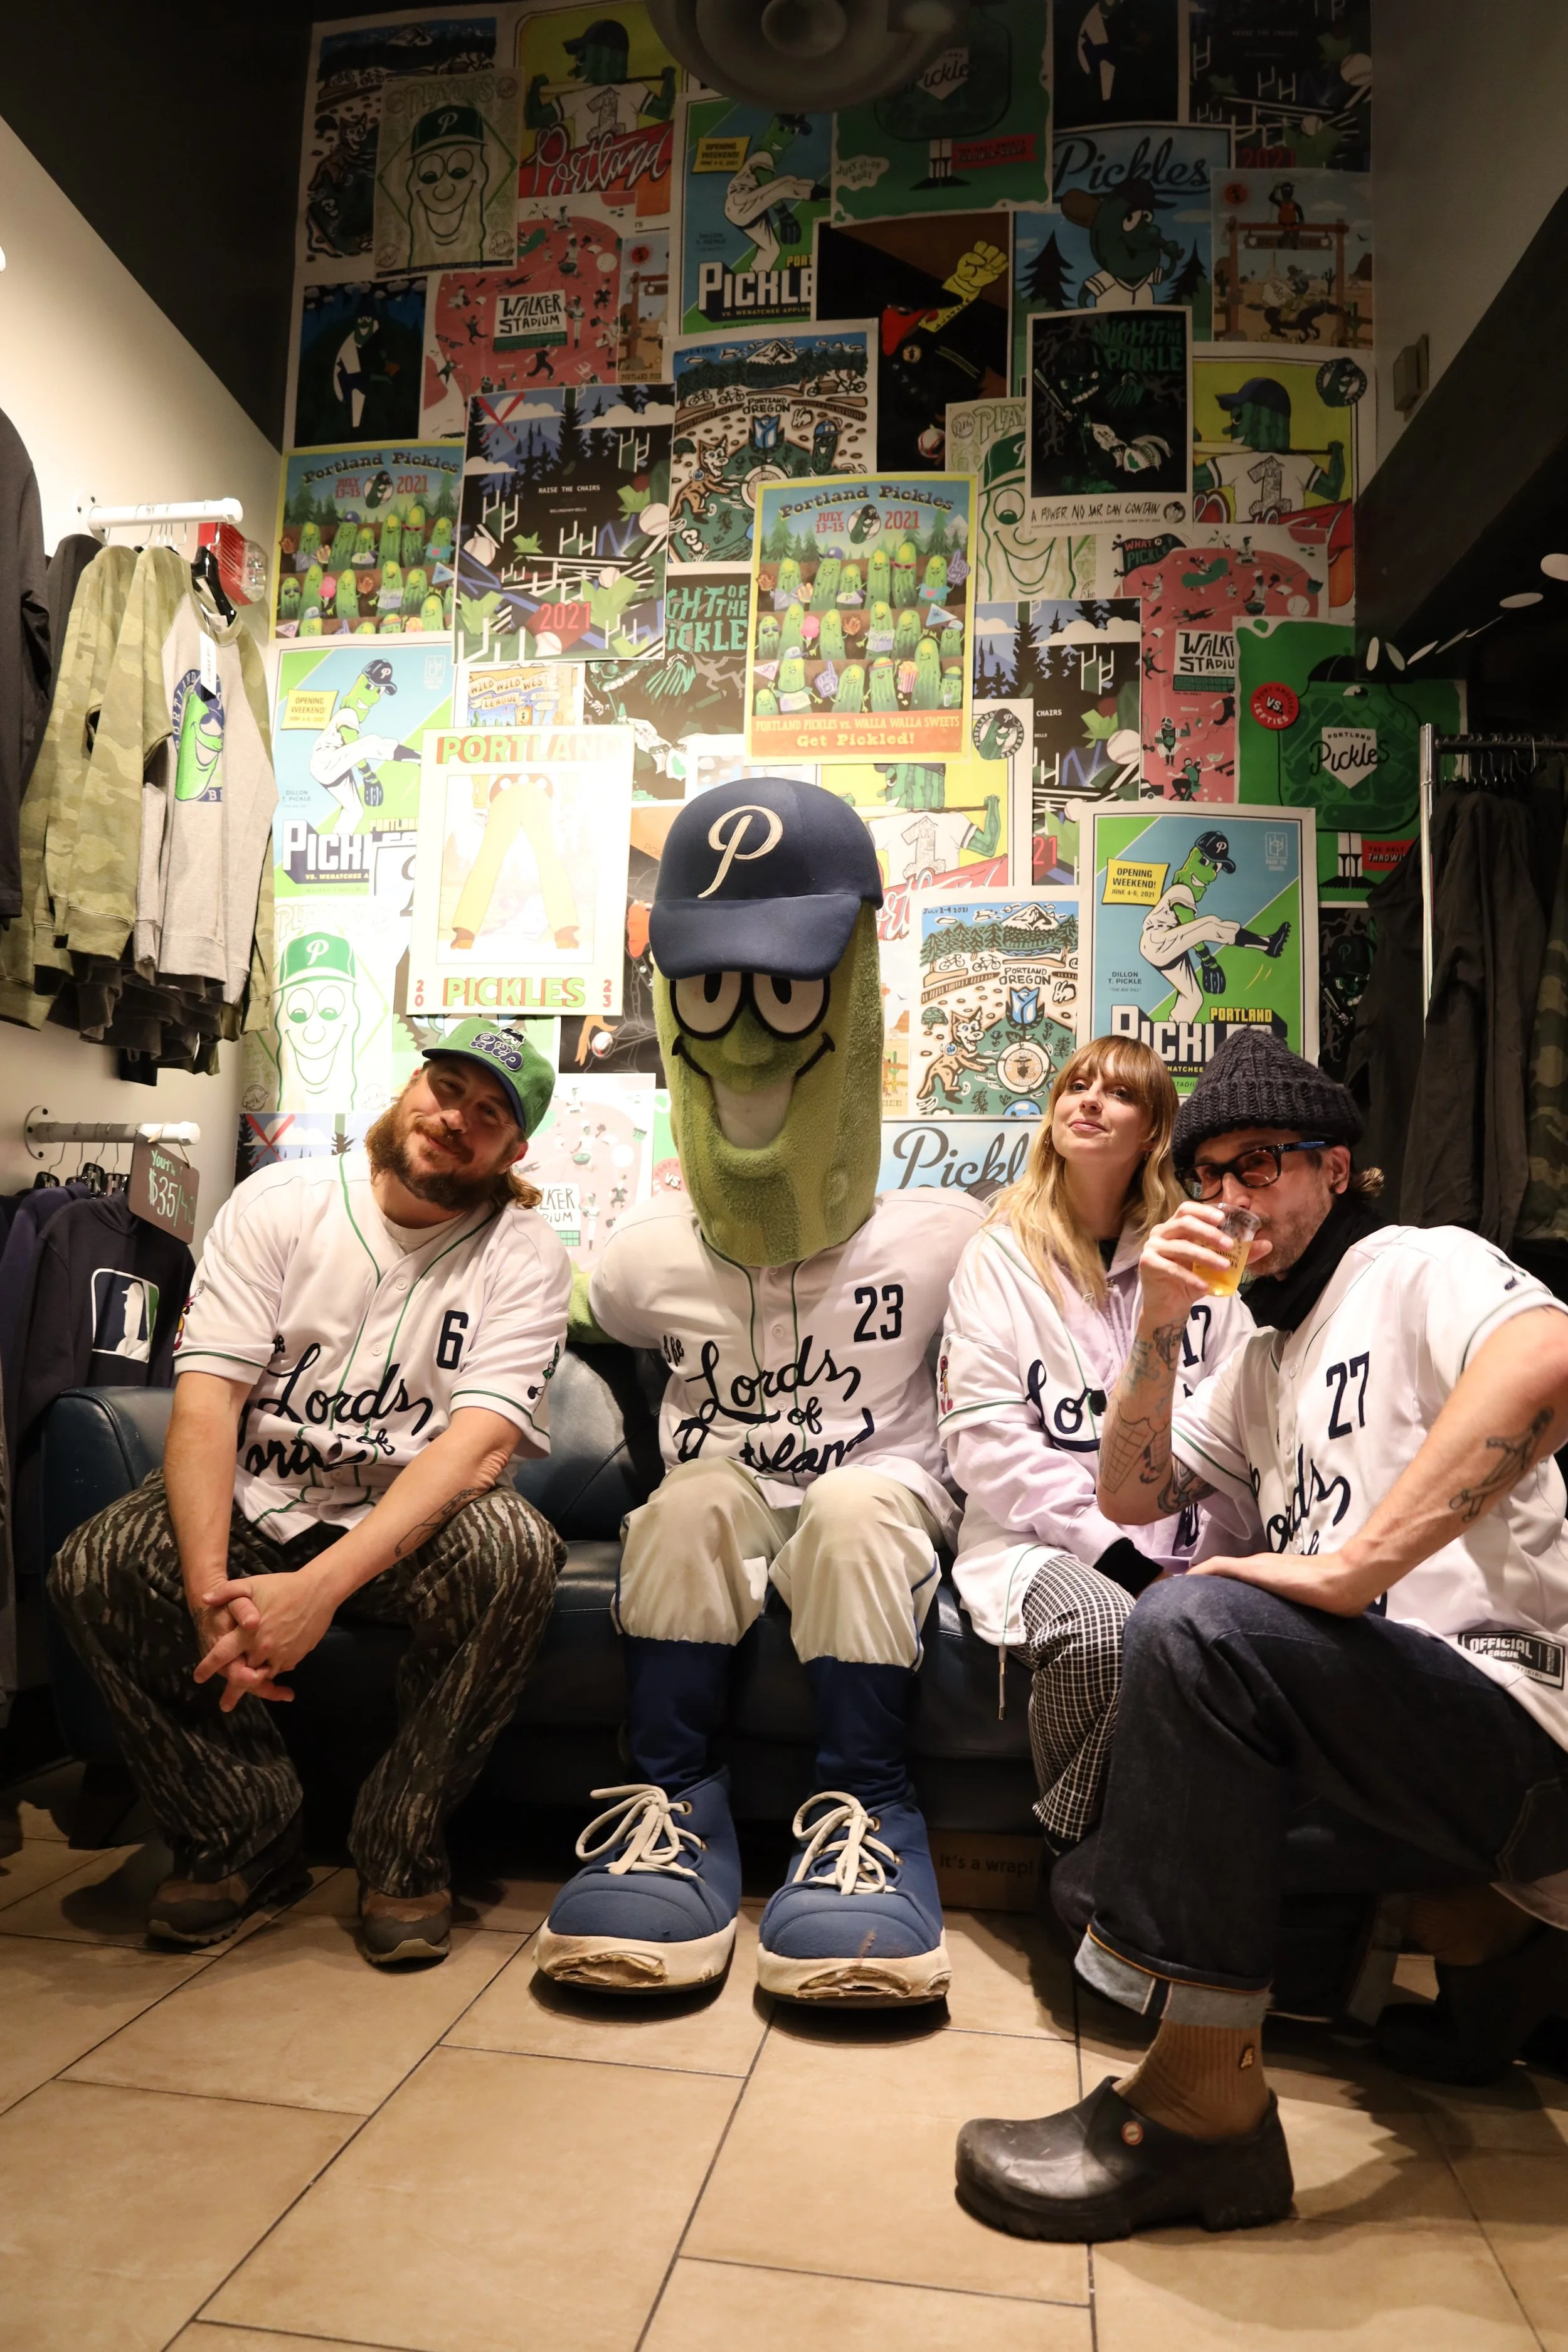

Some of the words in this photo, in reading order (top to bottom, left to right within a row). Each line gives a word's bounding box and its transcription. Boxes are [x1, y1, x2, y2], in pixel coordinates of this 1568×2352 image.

[527, 125, 672, 196] Portland
[1054, 135, 1207, 194] Pickles
[499, 293, 563, 317] WALKER
[736, 308, 780, 316] WENATCHEE
[499, 314, 560, 334] STADIUM
[742, 403, 790, 415] OREGON
[748, 397, 787, 405] PORTLAND
[303, 453, 384, 484] Portland
[392, 452, 460, 479] Pickles
[336, 477, 360, 489] JULY
[396, 475, 428, 494] 2021
[779, 485, 870, 520] Portland
[879, 485, 954, 511] Pickles
[1030, 510, 1037, 522] A
[1041, 506, 1068, 521] POWER
[1071, 505, 1084, 520] NO
[1088, 503, 1103, 517] JAR
[1106, 503, 1121, 516] CAN
[1125, 502, 1161, 515] CONTAIN
[817, 511, 844, 522] JULY
[884, 510, 920, 530] 2021
[815, 521, 844, 534] 13-15
[728, 584, 749, 599] OF
[539, 601, 591, 630] 2021
[715, 598, 748, 617] THE
[380, 667, 391, 679] P
[1254, 702, 1290, 725] LEFTIES
[1266, 696, 1283, 714] VS.
[755, 719, 802, 732] PORTLAND
[803, 719, 838, 731] PICKLES
[855, 718, 887, 729] WALLA
[890, 717, 923, 729] WALLA
[924, 716, 960, 728] SWEETS
[973, 712, 994, 746] PORTLAND
[796, 734, 827, 748] Get
[836, 733, 916, 748] Pickled!
[1327, 731, 1372, 741] PORTLAND
[436, 734, 623, 765] PORTLAND
[1309, 740, 1391, 776] Pickles
[698, 805, 783, 899] P
[1216, 841, 1227, 854] P
[1117, 867, 1153, 878] OPENING
[1113, 877, 1157, 889] WEEKEND!
[1127, 889, 1138, 898] 4-6,
[306, 939, 330, 966] P
[999, 975, 1051, 985] OREGON
[1005, 967, 1047, 976] PORTLAND
[442, 977, 586, 1008] PICKLES
[1210, 1007, 1273, 1023] PORTLAND
[893, 1126, 1029, 1190] Pickl
[854, 1284, 904, 1343] 23
[436, 1310, 469, 1370] 6
[258, 1342, 433, 1436] Lords
[684, 1335, 861, 1425] Lords
[1325, 1351, 1370, 1440] 27
[787, 1396, 823, 1435] of
[1469, 1637, 1533, 1660] OFFICIAL
[1483, 1649, 1520, 1660] LEAGUE
[970, 1858, 980, 1872] a
[985, 1860, 1034, 1878] wrap!
